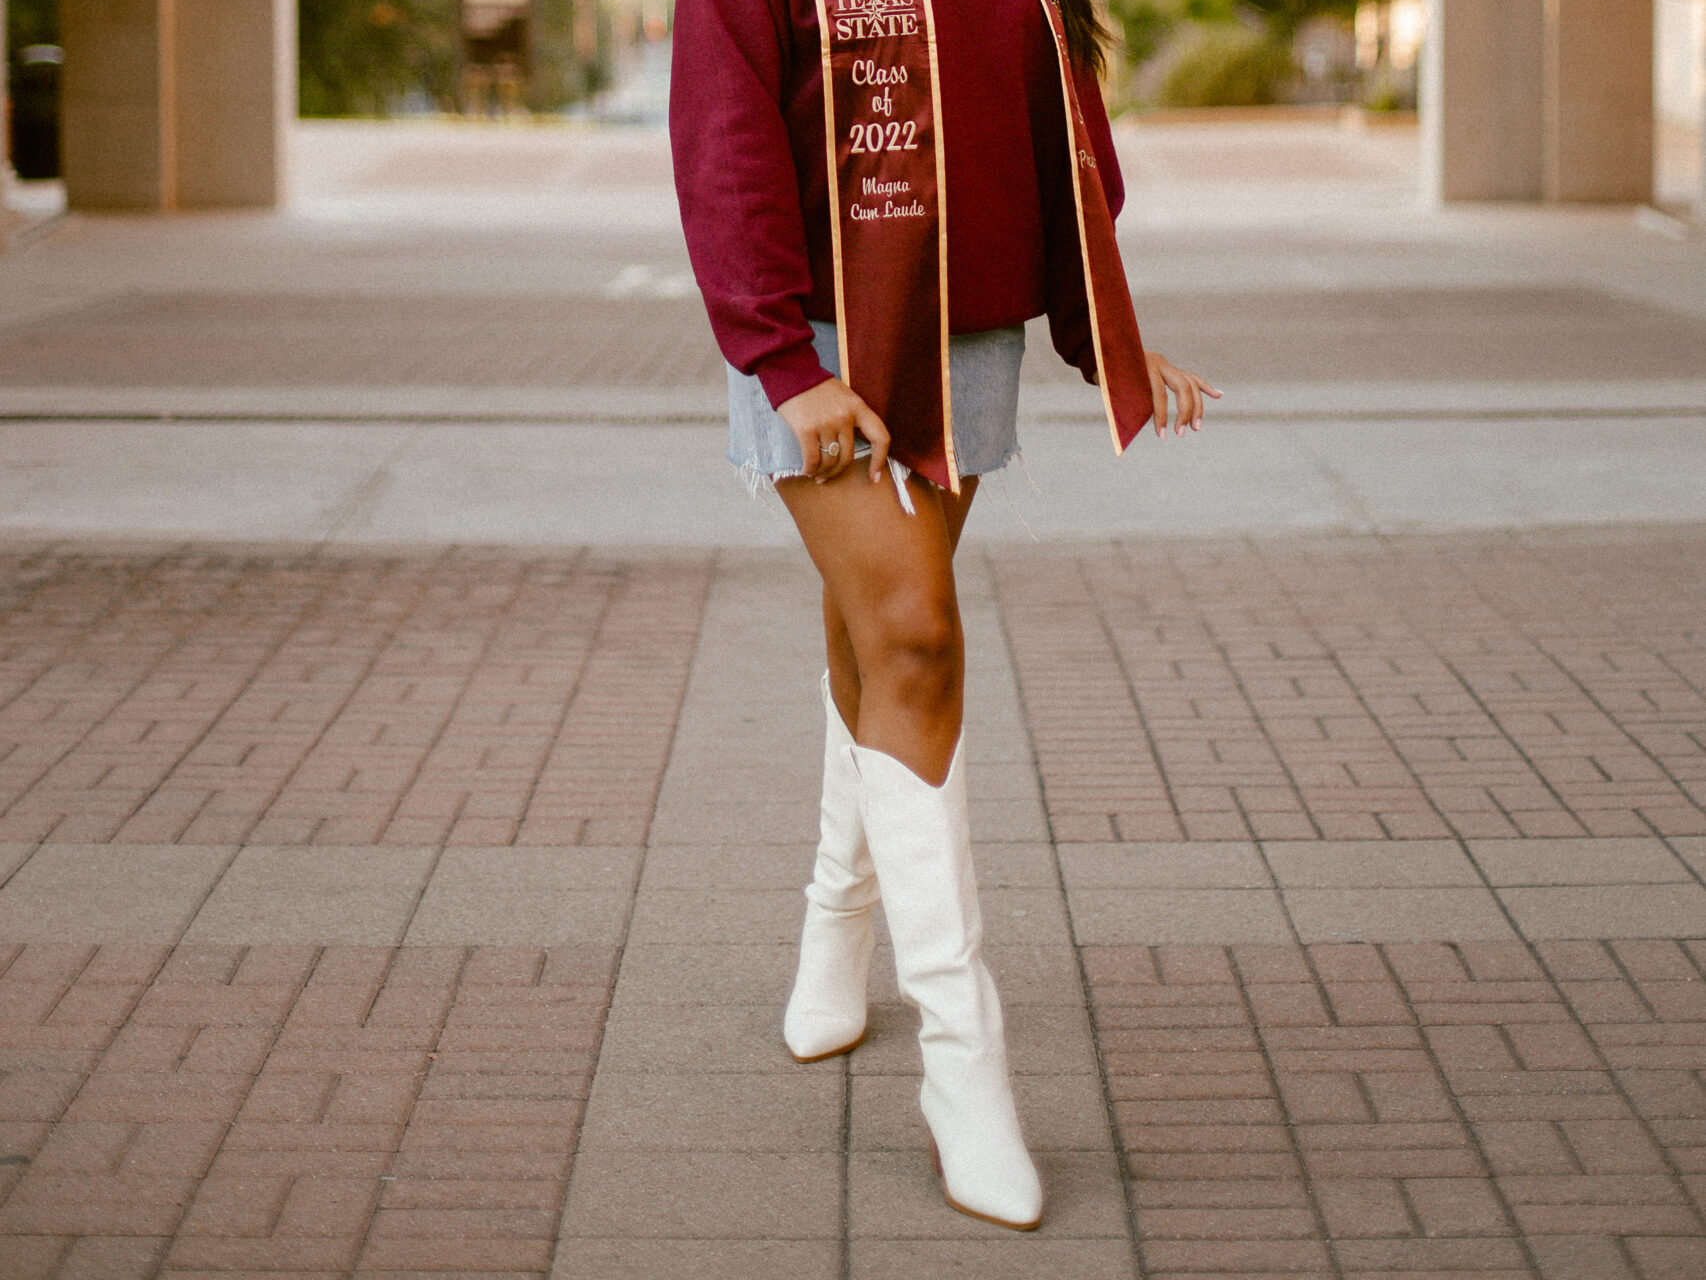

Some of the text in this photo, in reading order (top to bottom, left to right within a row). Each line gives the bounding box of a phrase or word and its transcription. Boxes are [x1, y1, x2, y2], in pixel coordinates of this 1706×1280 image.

[835, 13, 919, 41] STATE
[852, 59, 908, 86] Class
[872, 86, 893, 117] of
[850, 120, 918, 154] 2022
[862, 176, 911, 198] Magna
[850, 199, 926, 221] Cum Laude
